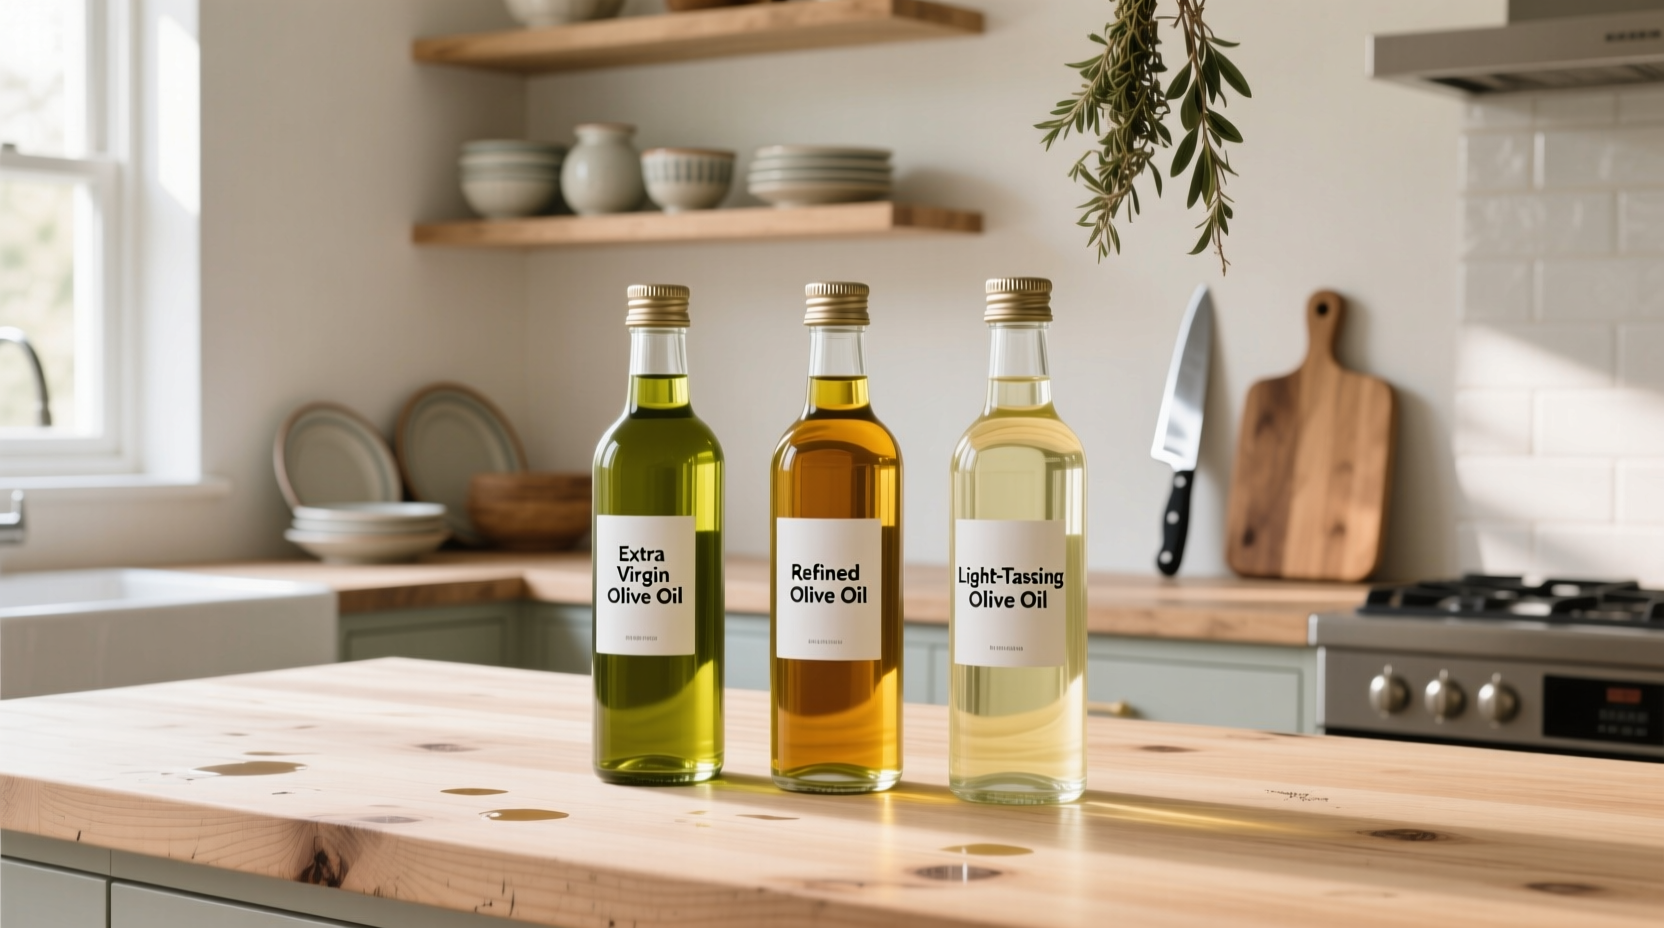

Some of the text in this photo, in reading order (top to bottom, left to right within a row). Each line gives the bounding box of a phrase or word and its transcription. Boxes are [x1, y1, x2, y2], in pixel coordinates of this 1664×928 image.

[619, 545, 665, 562] Extra
[616, 565, 670, 588] Virgin
[791, 563, 860, 582] Refined
[607, 586, 683, 605] Olive Oil
[790, 585, 868, 604] Olive Oil
[968, 589, 1048, 609] Olive Oil
